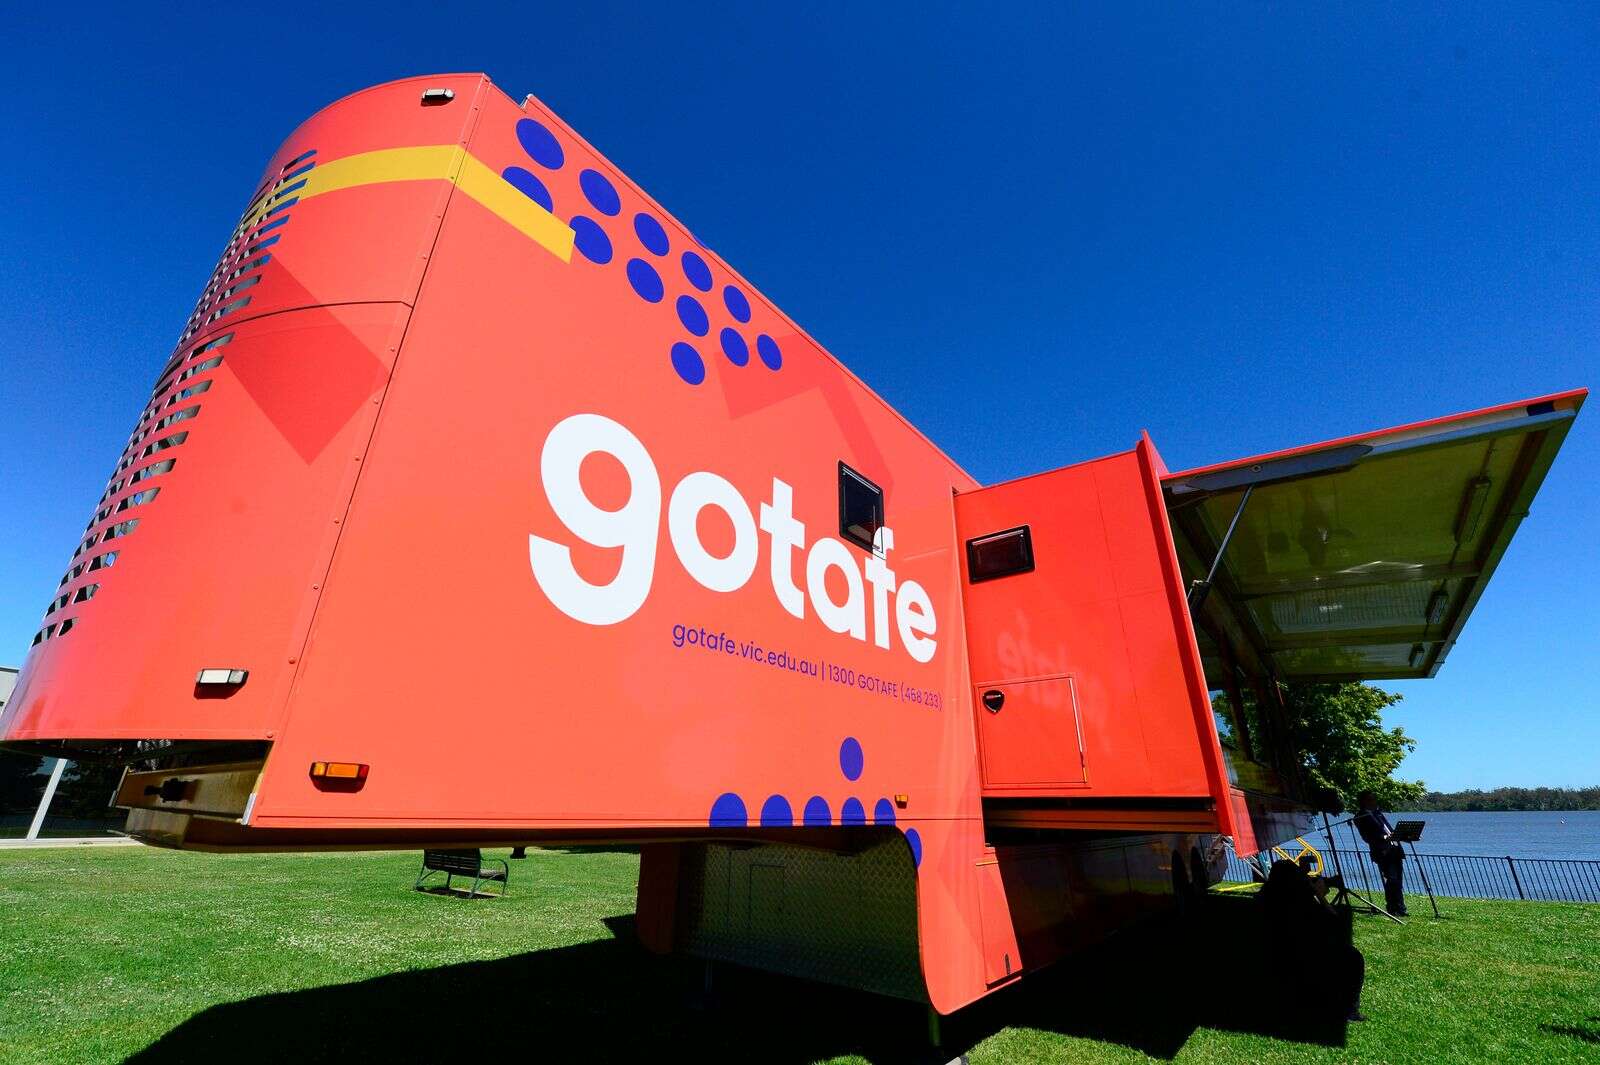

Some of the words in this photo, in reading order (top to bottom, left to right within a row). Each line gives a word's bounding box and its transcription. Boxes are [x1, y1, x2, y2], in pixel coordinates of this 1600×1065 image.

[529, 413, 937, 663] gotafe
[672, 623, 817, 676] gotafe.vic.edu.au
[828, 663, 855, 686] 1300
[857, 674, 898, 698] GOTAFE
